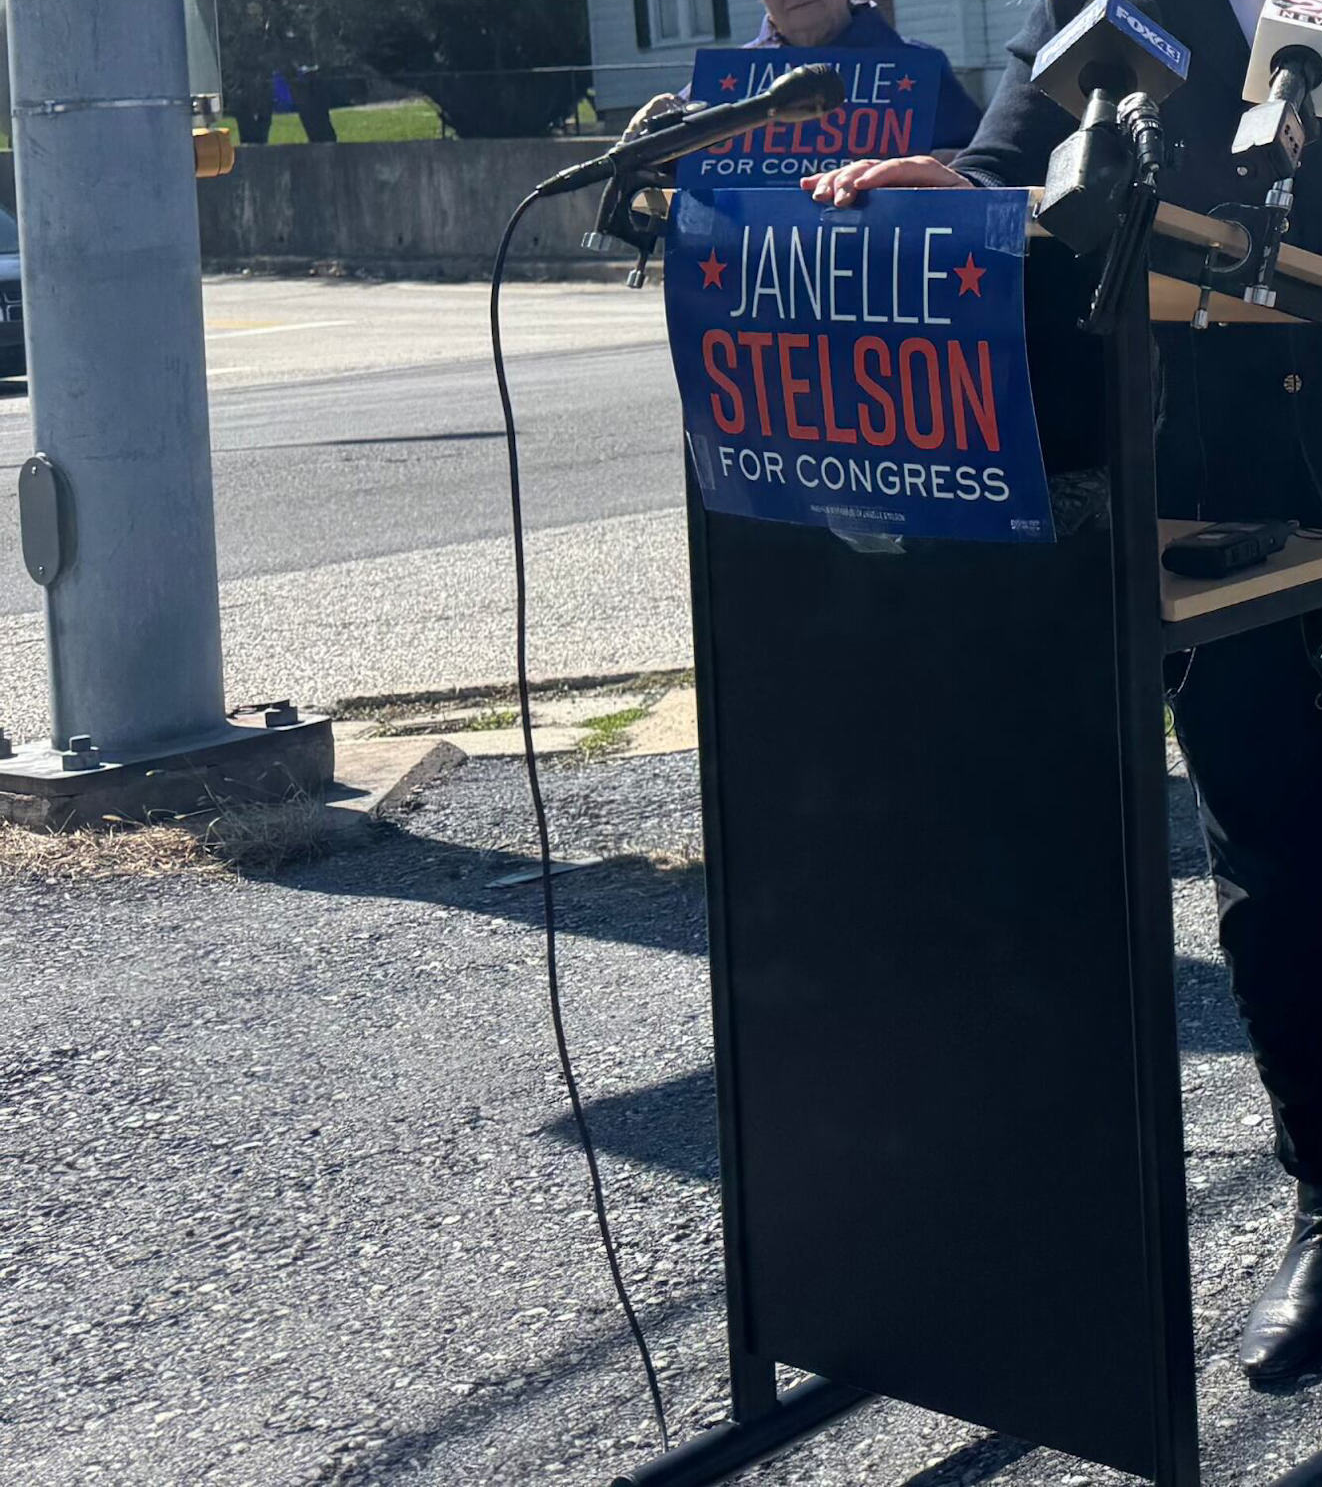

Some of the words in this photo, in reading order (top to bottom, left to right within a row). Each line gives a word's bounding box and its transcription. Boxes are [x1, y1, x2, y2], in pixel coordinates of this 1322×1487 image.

[701, 159, 753, 175] FOR
[730, 225, 953, 325] JANELLE
[702, 329, 1000, 452] STELSON
[719, 447, 786, 485] FOR
[796, 454, 1010, 502] CONGRESS
